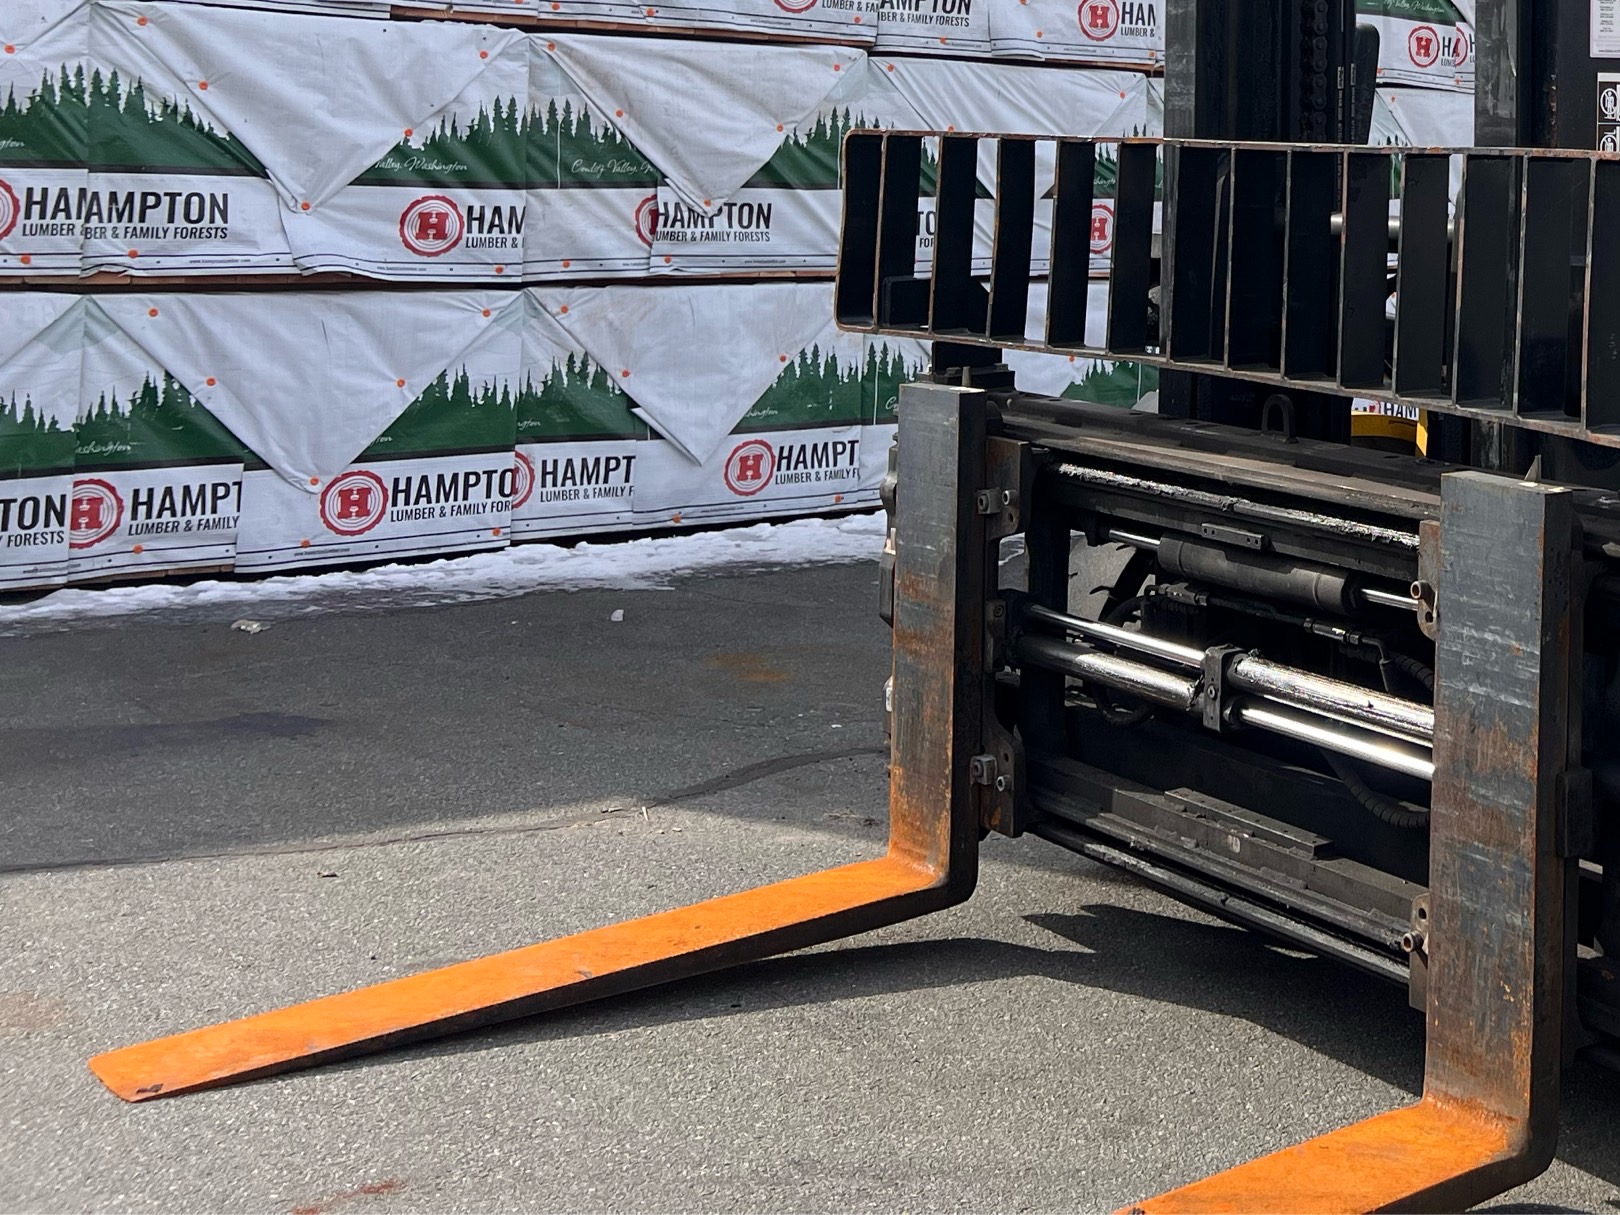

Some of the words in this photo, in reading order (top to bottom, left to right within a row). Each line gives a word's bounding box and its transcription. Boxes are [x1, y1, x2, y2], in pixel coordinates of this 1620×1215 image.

[857, 1, 863, 12] &
[900, 12, 906, 23] &
[908, 13, 934, 25] FAMILY
[936, 15, 970, 28] FORESTS
[1120, 26, 1148, 38] LUMBER
[22, 223, 75, 237] LUMBER
[111, 227, 120, 240] &
[124, 226, 168, 240] FAMILY
[174, 226, 228, 240] FORESTS
[690, 232, 697, 242] &
[700, 231, 731, 242] FAMILY
[734, 232, 770, 242] FORESTS
[465, 237, 507, 249] LUMBER
[511, 238, 518, 248] &
[776, 440, 860, 472] HAMPT
[775, 472, 812, 484] LUMBER
[815, 472, 821, 482] &
[824, 469, 850, 481] FAMILY
[391, 468, 514, 508] HAMPTO
[540, 489, 580, 503] LUMBER
[584, 488, 590, 500] &
[593, 486, 627, 498] FAMILY
[390, 507, 436, 522] LUMBER
[439, 506, 447, 518] &
[450, 501, 488, 516] FAMILY
[128, 521, 180, 536] LUMBER
[183, 520, 192, 532] &
[196, 516, 240, 532] FAMILY
[7, 530, 64, 548] FORESTS
